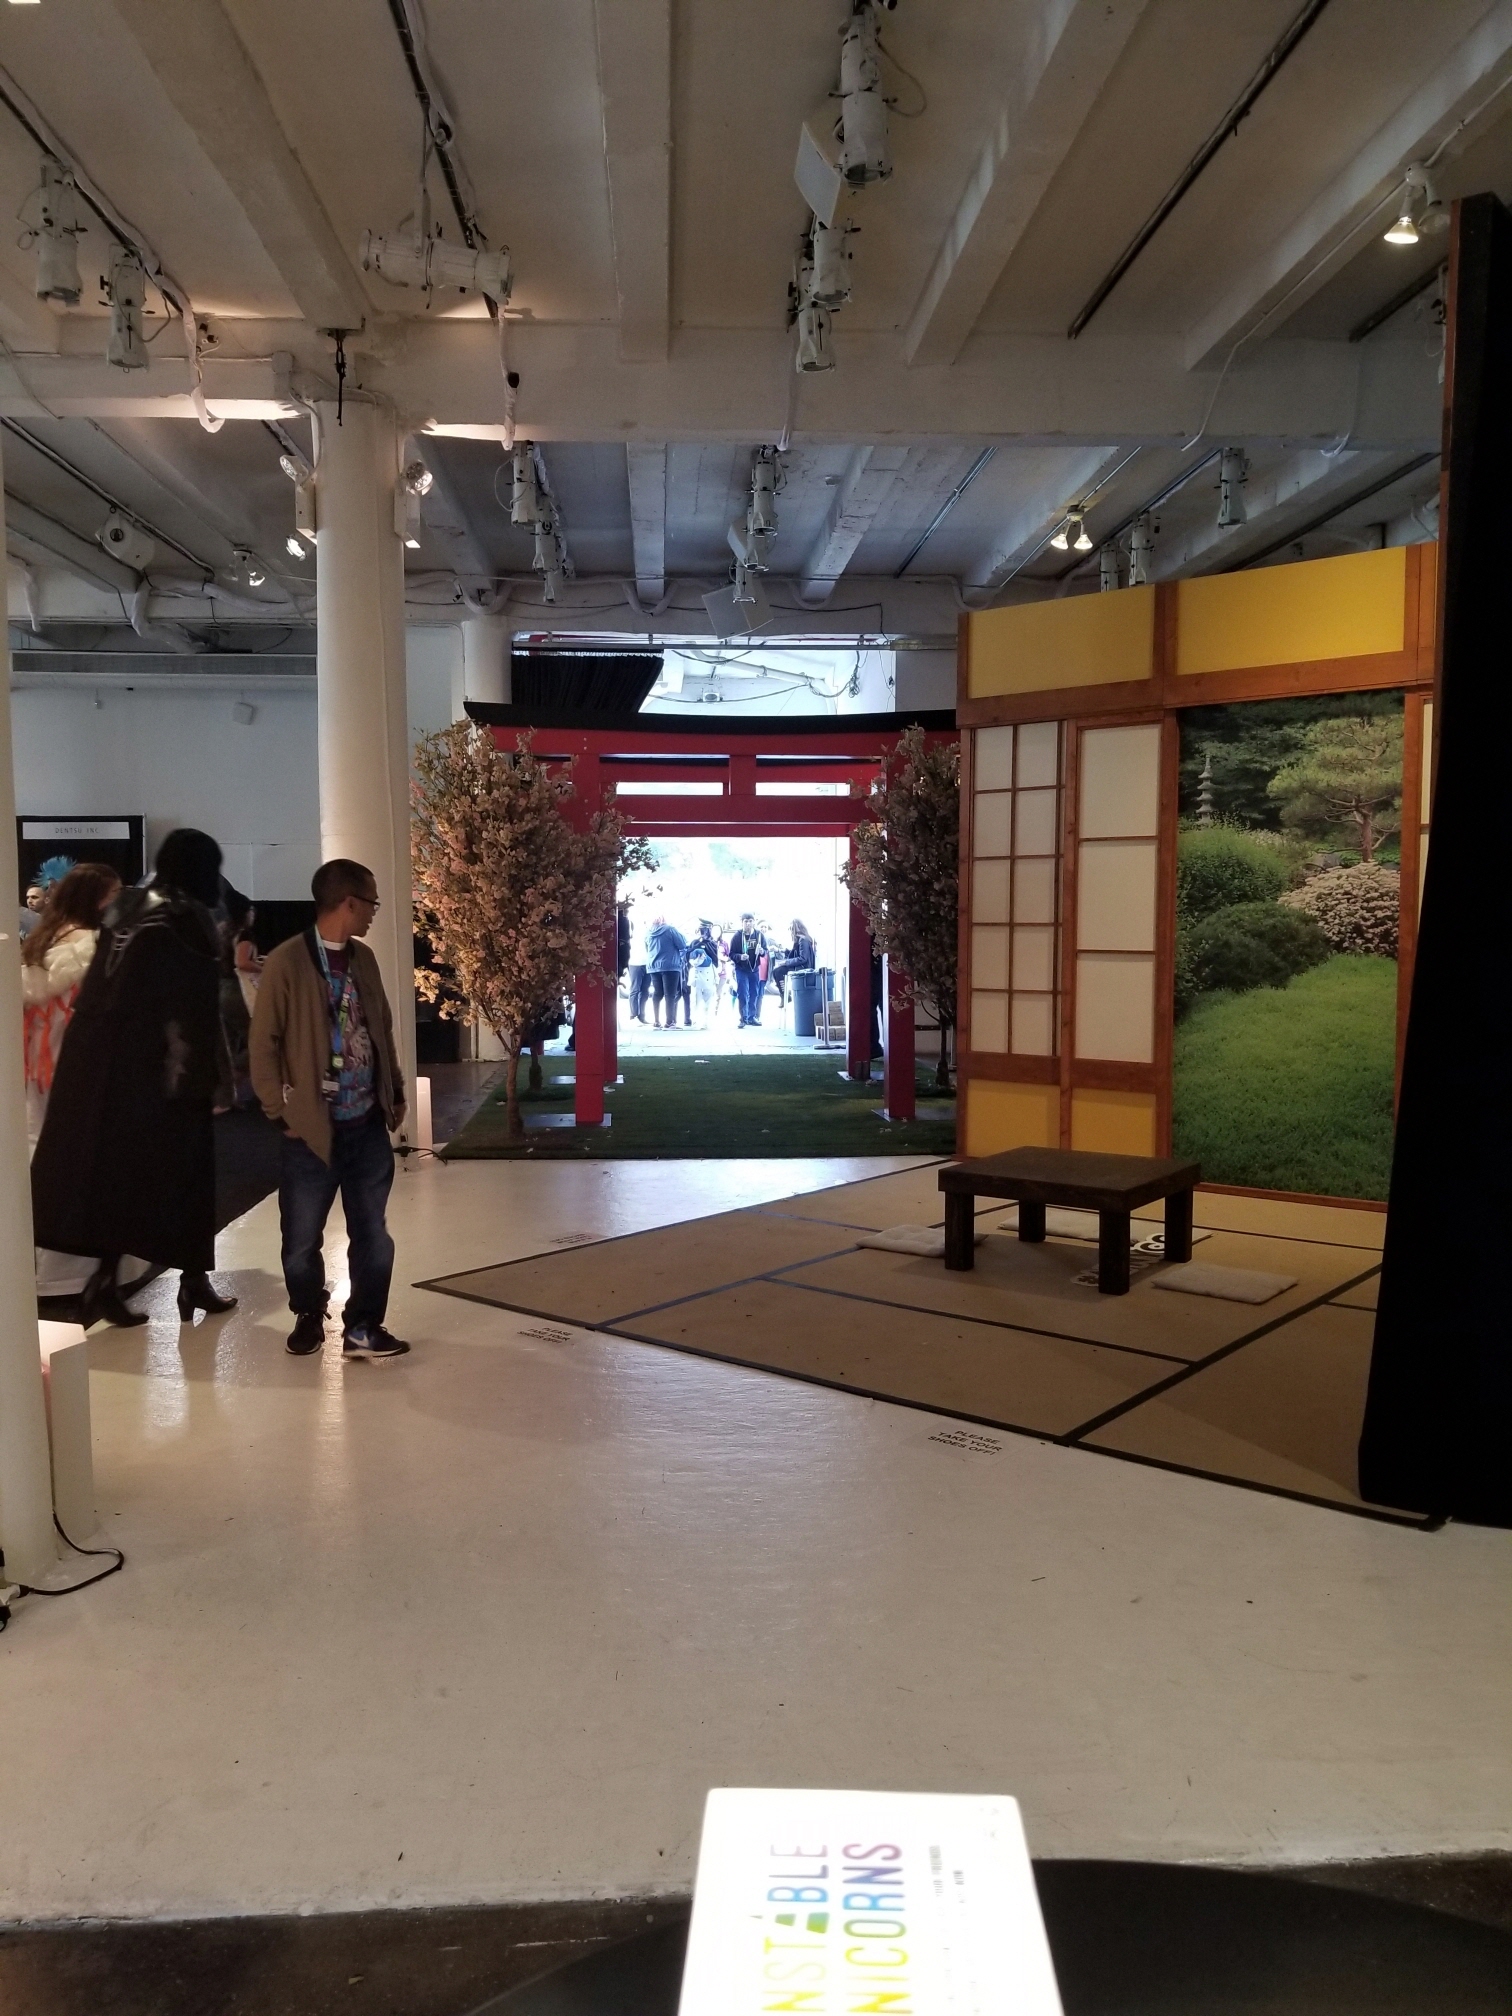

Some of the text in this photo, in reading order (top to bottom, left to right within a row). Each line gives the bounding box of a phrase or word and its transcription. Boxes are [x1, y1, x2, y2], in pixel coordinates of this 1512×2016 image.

[927, 1435, 996, 1456] SHOES OFF!
[938, 1431, 1003, 1452] TAKE YOUR
[954, 1430, 1001, 1444] PLEASE
[750, 1844, 830, 2013] NSTABLE
[841, 1843, 914, 2015] NICORNS
